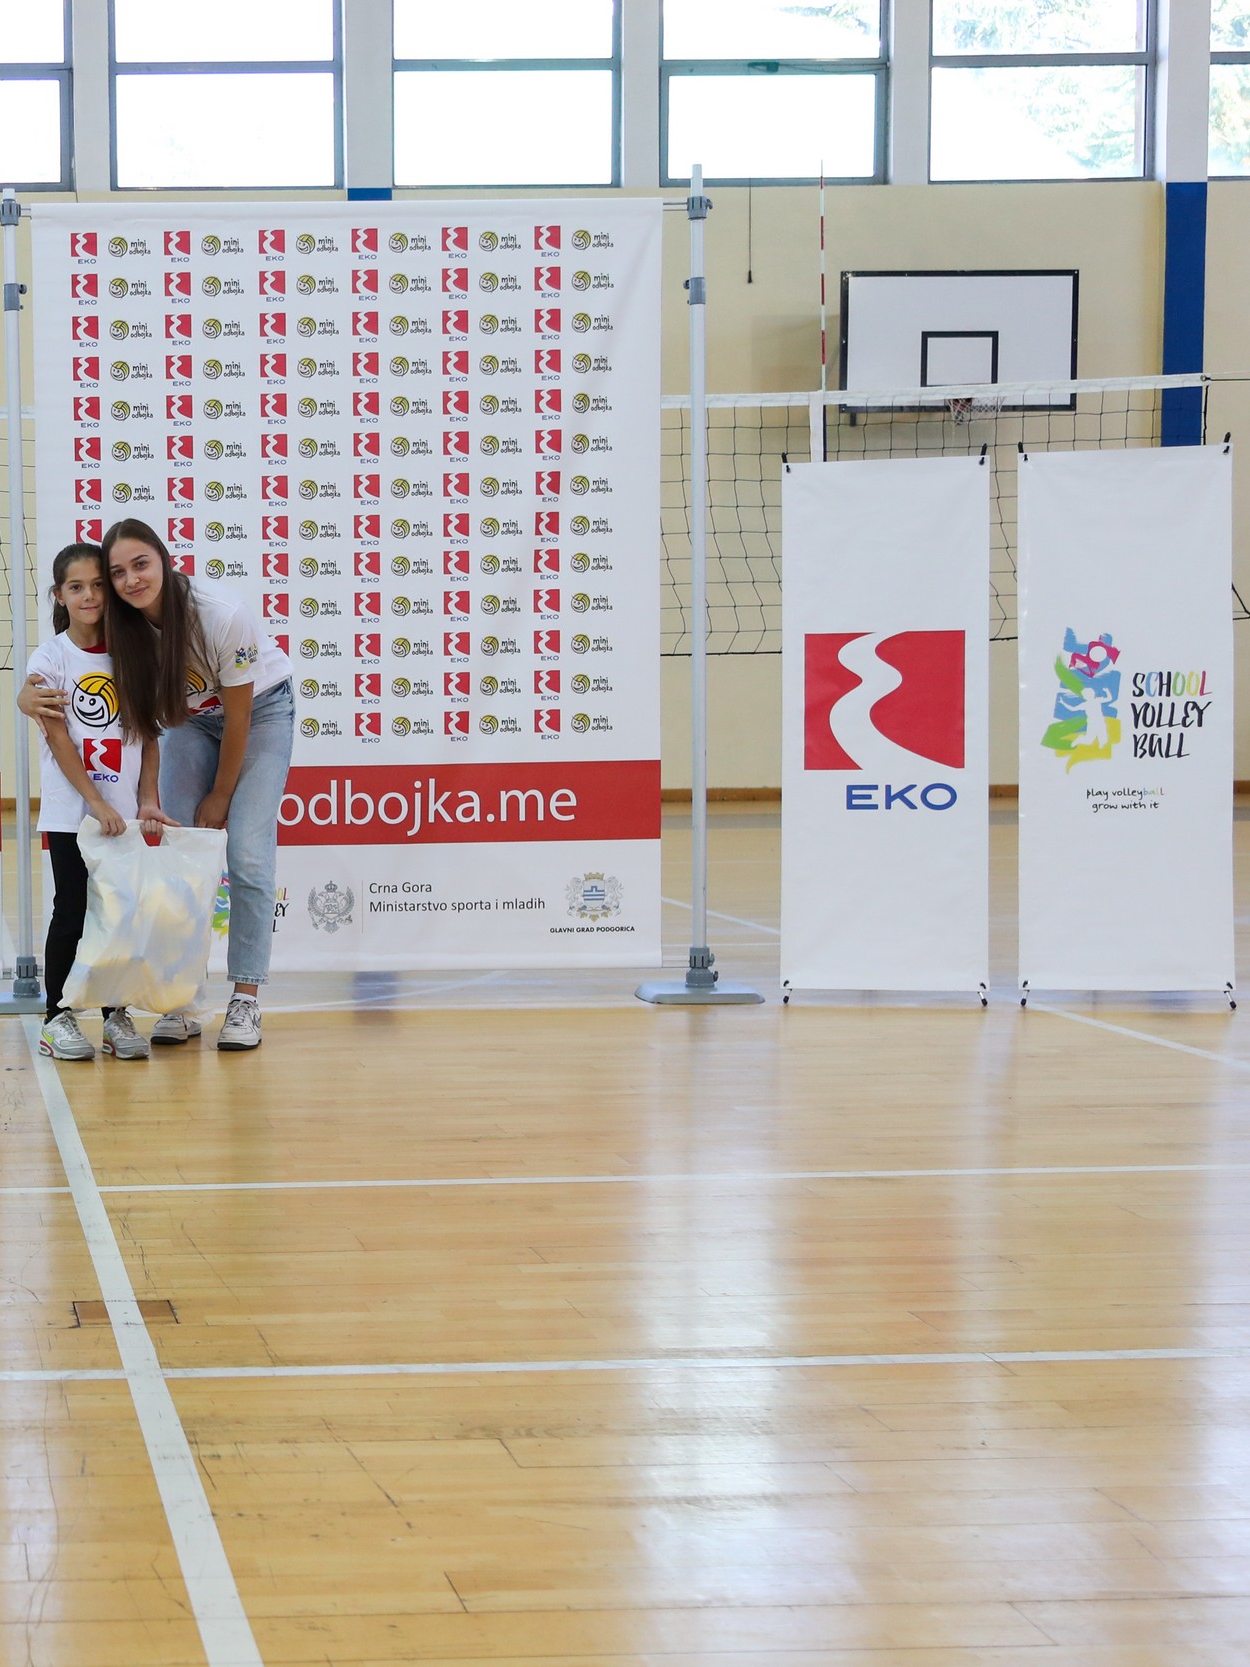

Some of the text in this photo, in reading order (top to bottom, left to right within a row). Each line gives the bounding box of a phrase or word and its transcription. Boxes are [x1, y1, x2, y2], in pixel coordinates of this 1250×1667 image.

[130, 239, 146, 248] mini
[128, 247, 152, 256] odbojka
[318, 277, 334, 286] mini
[318, 285, 340, 294] odbojka
[501, 316, 518, 325] mini
[131, 322, 148, 331] mini
[500, 324, 522, 334] odbojka
[130, 330, 153, 340] odbojka
[224, 361, 240, 370] mini
[224, 369, 246, 378] odbojka
[411, 398, 428, 407] mini
[410, 406, 433, 416] odbojka
[592, 436, 608, 445] mini
[133, 443, 150, 452] mini
[592, 444, 613, 452] odbojka
[132, 451, 155, 460] odbojka
[501, 479, 518, 488] mini
[500, 487, 523, 496] odbojka
[449, 497, 469, 505] EKO
[320, 522, 336, 531] mini
[320, 530, 342, 540] odbojka
[320, 560, 336, 569] mini
[502, 557, 518, 566] mini
[320, 568, 342, 576] odbojka
[502, 565, 523, 574] odbojka
[413, 598, 428, 607] mini
[412, 606, 434, 616] odbojka
[592, 636, 608, 645] mini
[592, 644, 614, 654] odbojka
[501, 678, 516, 687] mini
[1132, 670, 1212, 698] SCHOOL
[502, 686, 522, 694] odbojka
[203, 703, 223, 715] EK
[1130, 701, 1212, 729] VOLLEY
[501, 717, 518, 726] mini
[502, 725, 522, 734] odbojka
[93, 773, 119, 783] EKO
[846, 782, 958, 811] EKO
[1086, 787, 1166, 801] play volleyball
[1092, 800, 1160, 813] grow with it
[369, 882, 432, 894] Crna Gora
[369, 898, 545, 914] Ministarstvo sporta i mladih
